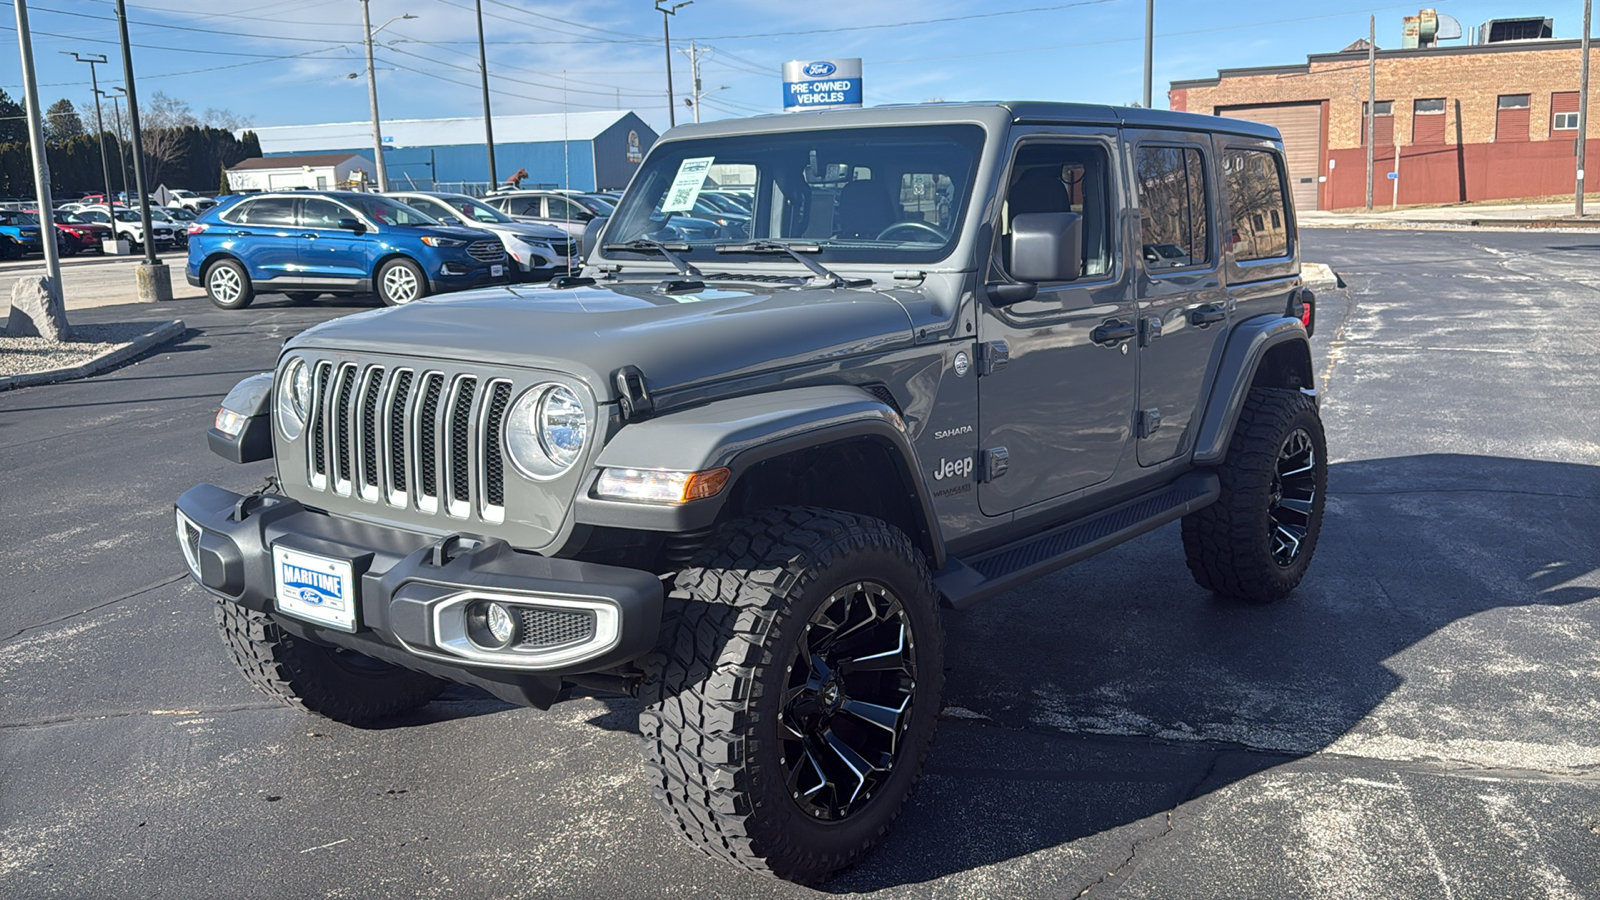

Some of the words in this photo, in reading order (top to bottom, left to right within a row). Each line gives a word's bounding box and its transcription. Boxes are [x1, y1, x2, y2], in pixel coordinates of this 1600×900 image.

[809, 64, 828, 75] Ford
[797, 92, 844, 103] VEHICLES
[934, 425, 973, 439] SAHARA
[934, 456, 973, 480] Jeep
[283, 565, 341, 597] MARITIME
[303, 590, 319, 603] Ford
